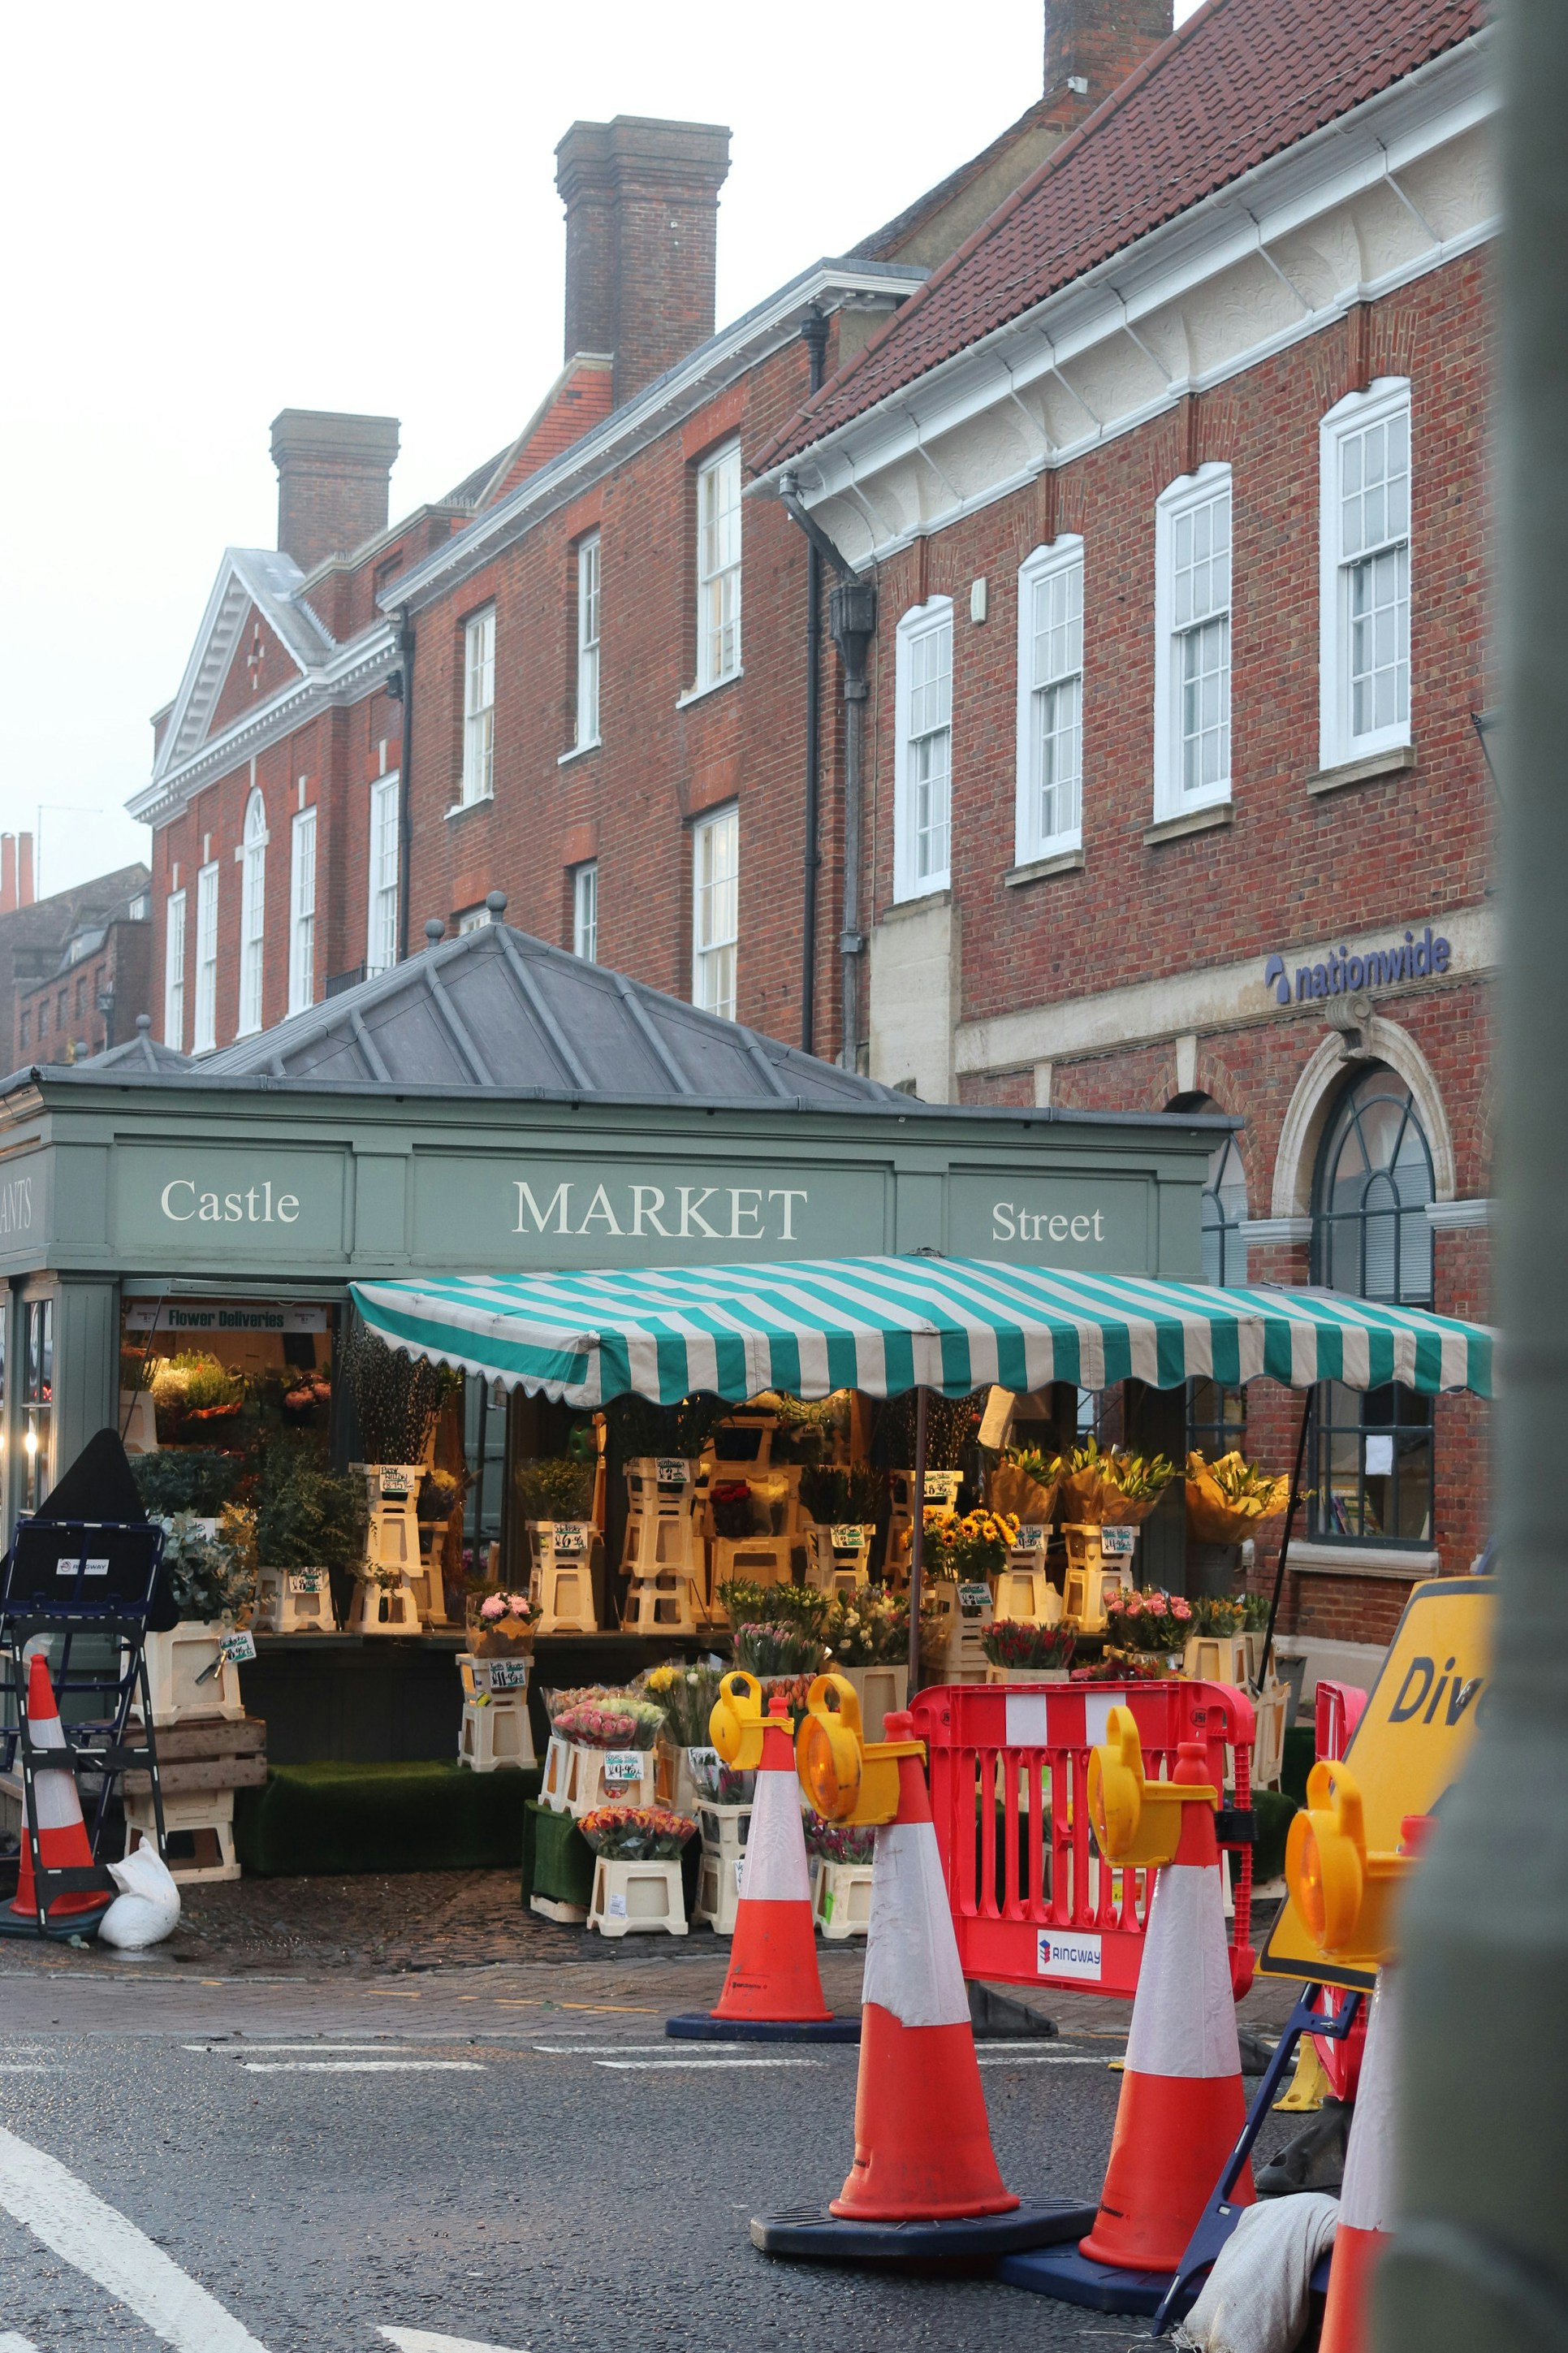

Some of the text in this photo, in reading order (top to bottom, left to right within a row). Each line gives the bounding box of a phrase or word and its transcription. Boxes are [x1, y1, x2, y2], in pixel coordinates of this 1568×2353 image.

[1295, 927, 1452, 1001] nationwide
[161, 1180, 1105, 1242] Castle MARKET Street
[168, 1309, 215, 1326] Flower
[218, 1310, 284, 1327] Deliveries
[1387, 1656, 1487, 1726] Div
[1052, 1947, 1100, 1965] RINGWAY
